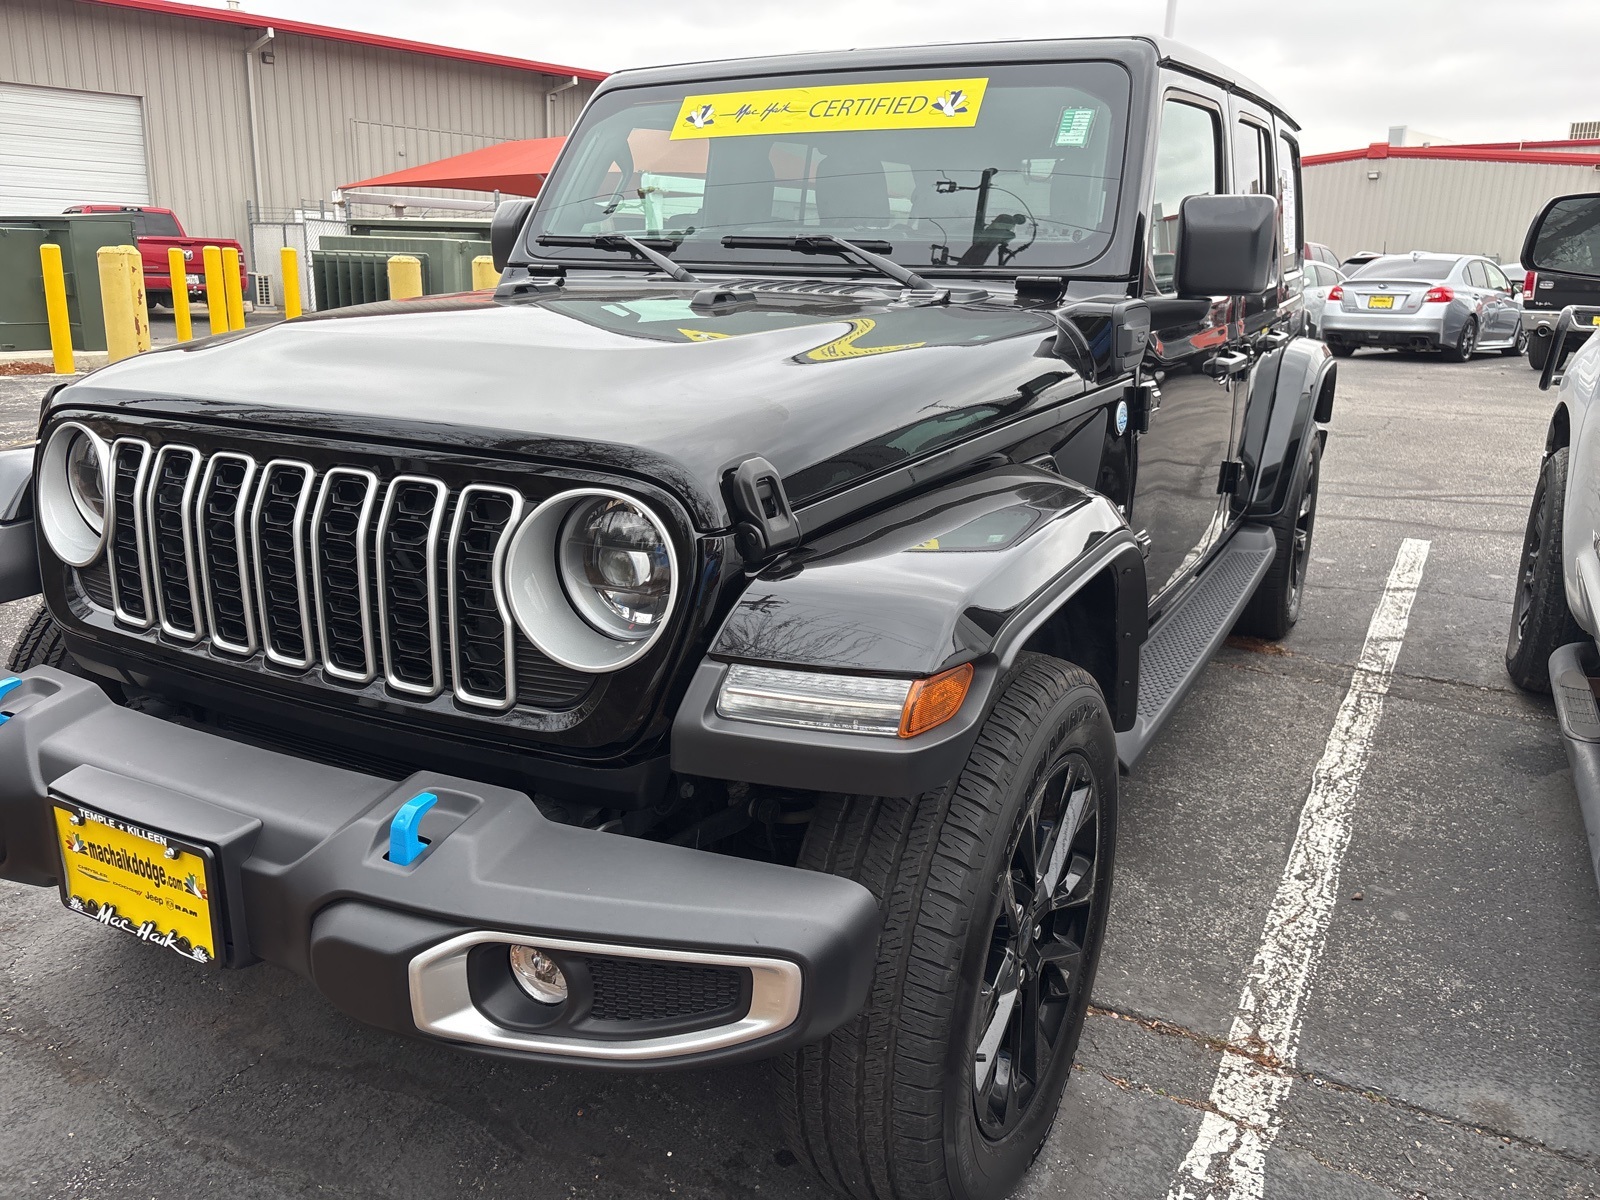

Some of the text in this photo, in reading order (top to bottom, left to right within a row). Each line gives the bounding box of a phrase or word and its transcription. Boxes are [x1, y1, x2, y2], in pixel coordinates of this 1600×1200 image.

[721, 96, 928, 123] Mac Haik CERTIFIED
[79, 808, 167, 847] TEMPLE KILLEEN
[87, 841, 184, 892] machaikdodge.com
[97, 904, 136, 931] Mac
[145, 891, 164, 906] Jeep
[175, 904, 198, 917] RAM
